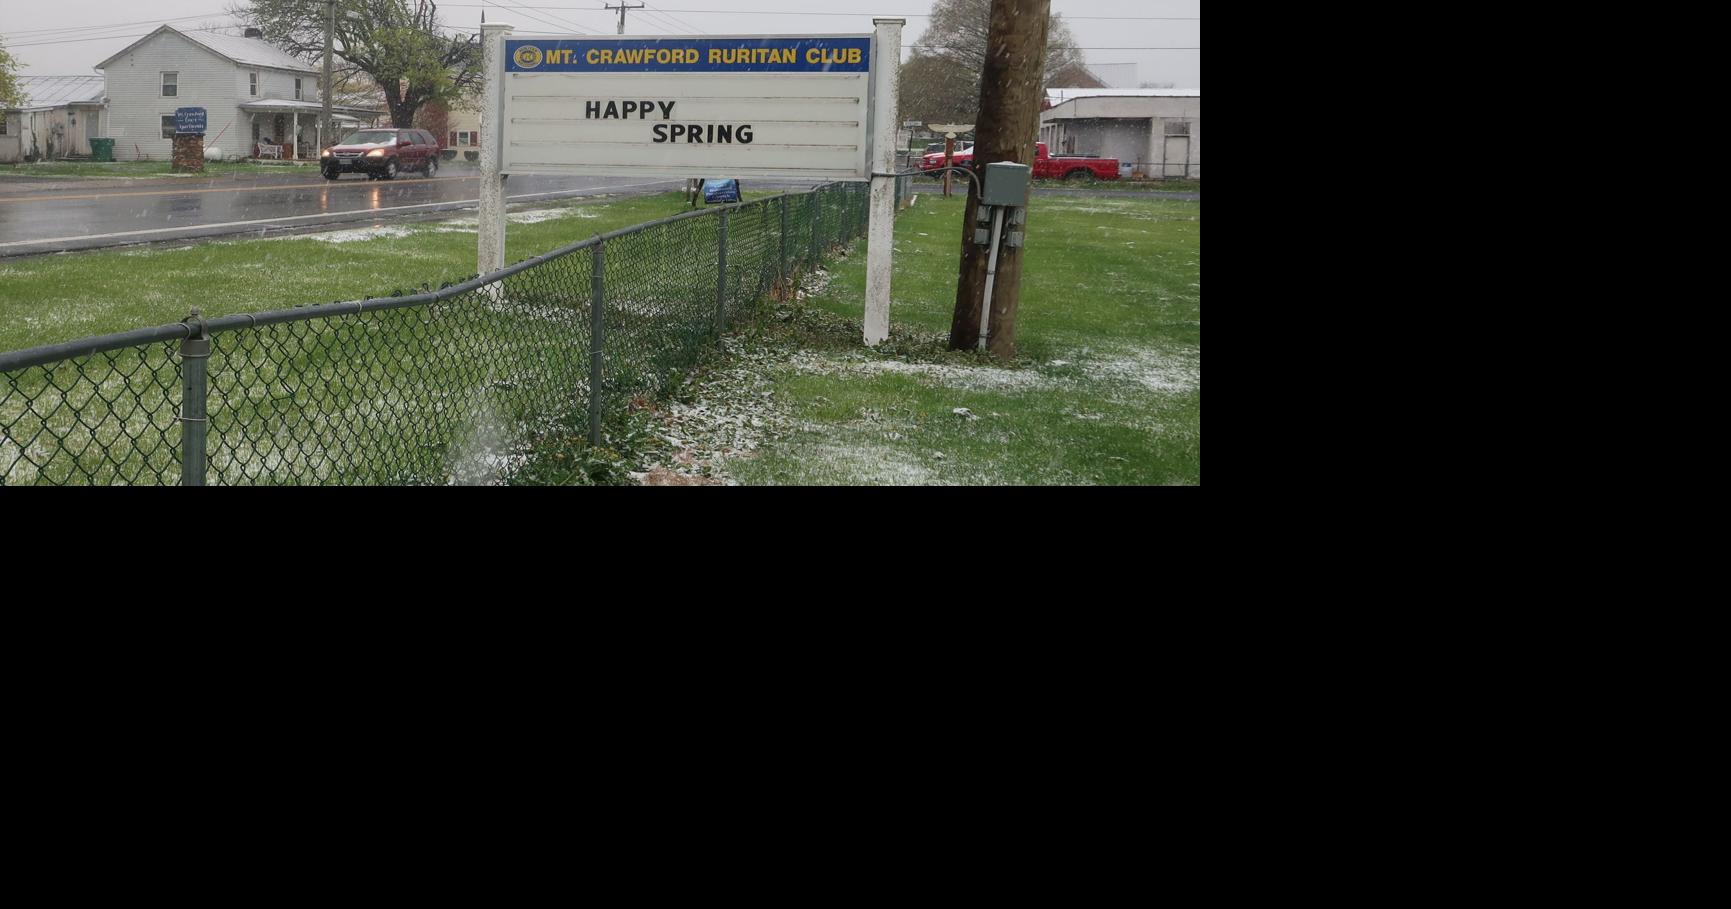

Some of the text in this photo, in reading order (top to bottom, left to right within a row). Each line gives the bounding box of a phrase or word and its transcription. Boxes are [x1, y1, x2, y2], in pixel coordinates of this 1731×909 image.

[546, 49, 577, 64] MT.
[586, 48, 700, 64] CRAWFORD
[708, 48, 797, 64] RURITAN
[805, 48, 862, 64] CLUB
[585, 100, 676, 120] HAPPY
[652, 123, 753, 143] SPRING
